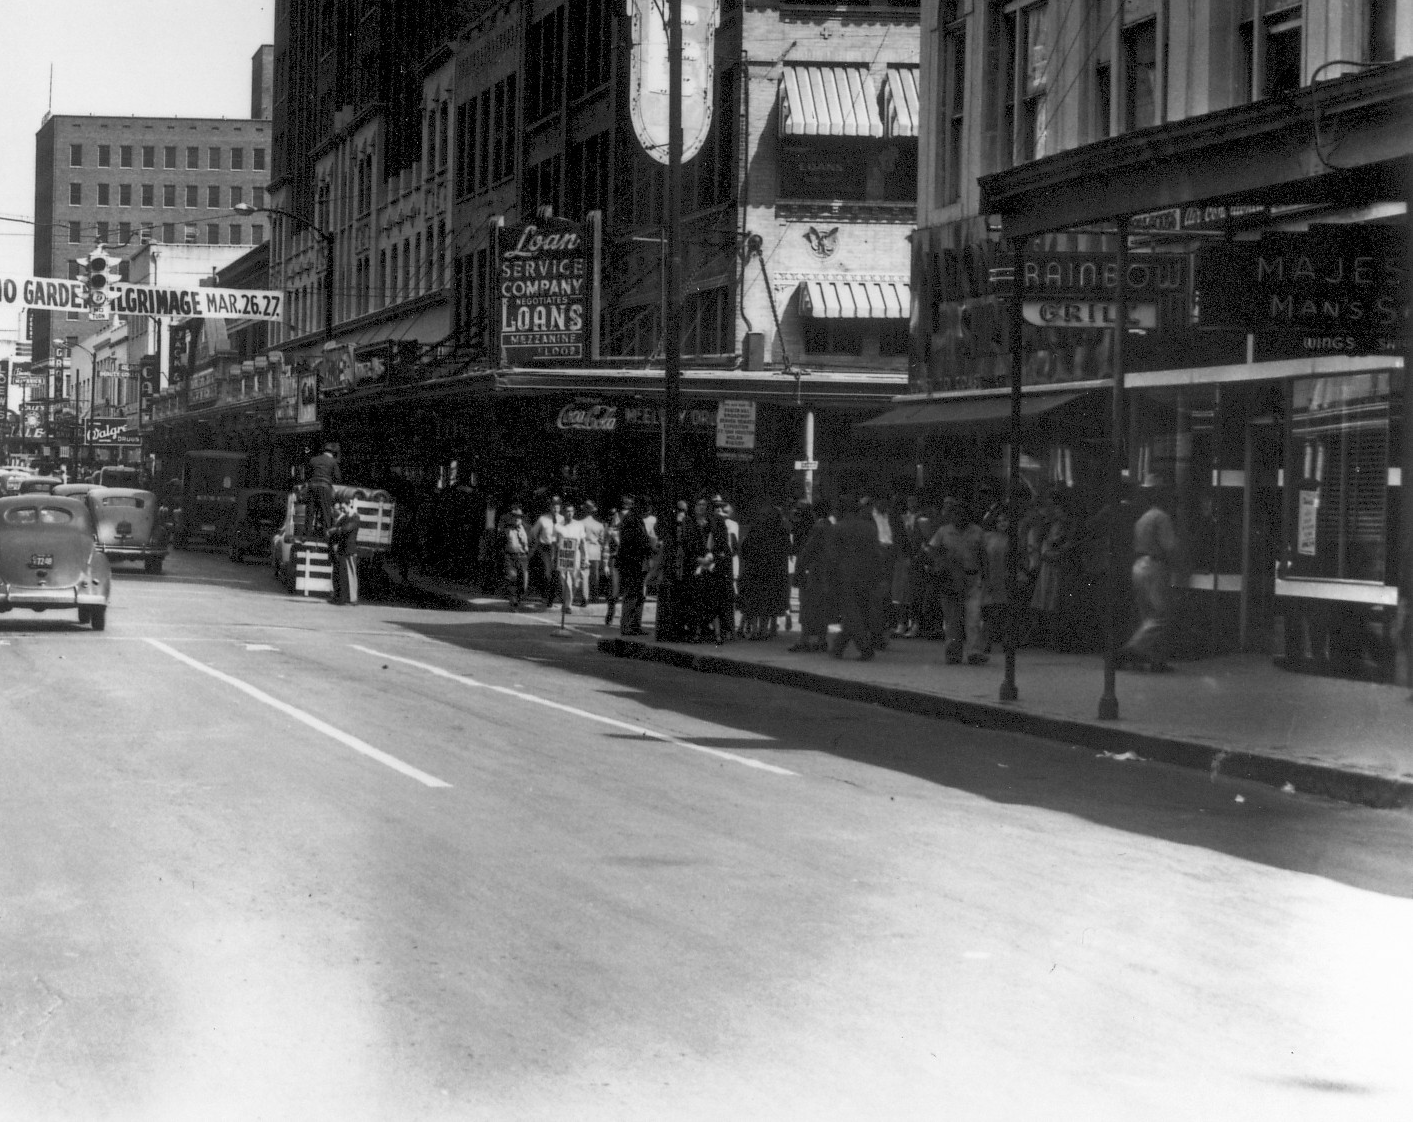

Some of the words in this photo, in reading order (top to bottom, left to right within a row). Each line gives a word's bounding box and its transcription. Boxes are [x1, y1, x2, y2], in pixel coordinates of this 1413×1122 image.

[504, 226, 581, 258] Loan
[502, 259, 583, 278] SERVICE
[1025, 261, 1180, 289] RAINBOW
[502, 279, 583, 297] COMPANY
[110, 287, 202, 315] ILGRIMAGE
[516, 296, 568, 305] NEGOTIATES
[502, 298, 583, 331] LOANS
[510, 334, 576, 345] MEZZANINE
